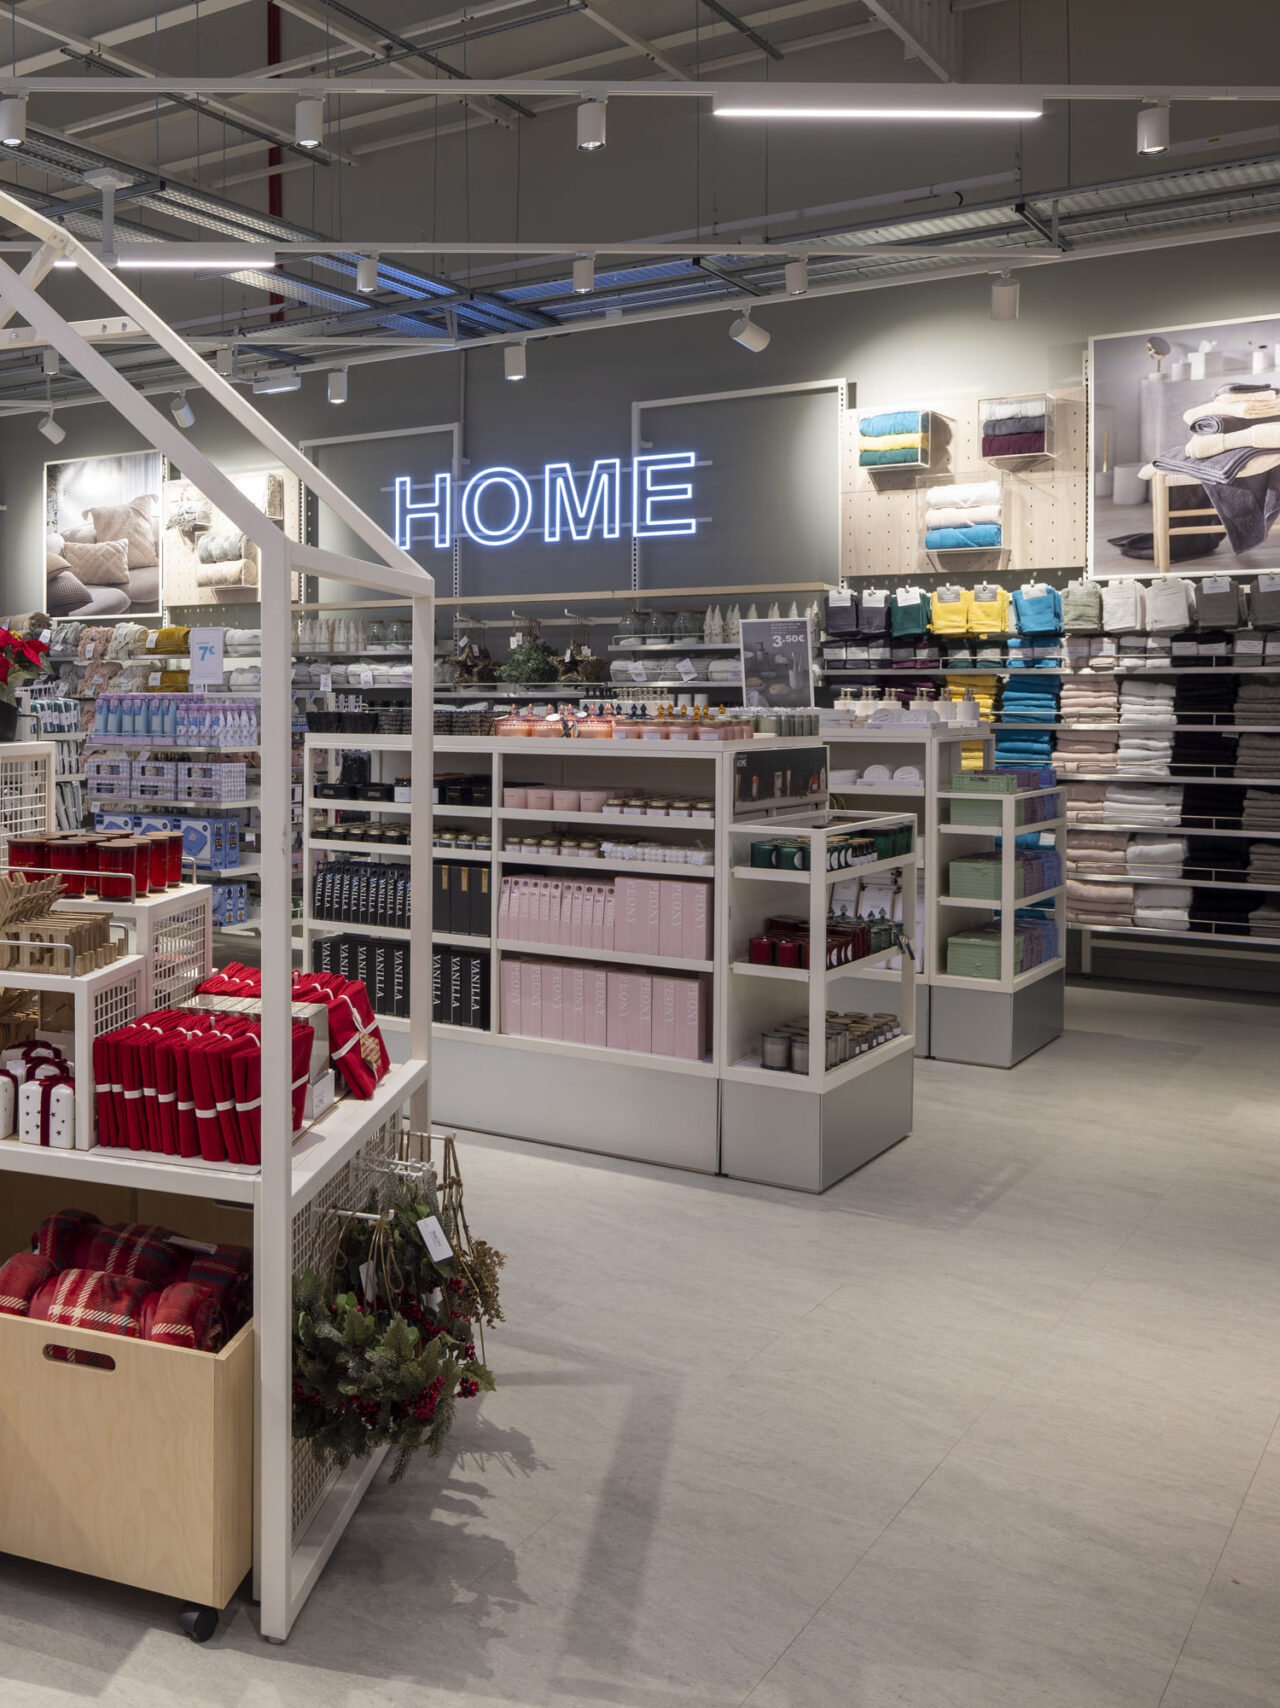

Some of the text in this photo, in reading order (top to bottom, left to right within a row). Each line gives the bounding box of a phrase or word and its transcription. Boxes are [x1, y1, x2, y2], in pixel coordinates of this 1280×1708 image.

[395, 452, 696, 550] HOME
[198, 645, 215, 661] 7€
[315, 873, 323, 906] VANILLA
[342, 874, 350, 909] VANILLA
[626, 880, 637, 925] PEONY
[648, 883, 659, 927] PEONY
[672, 885, 682, 928] PEONY
[696, 886, 705, 929] PEONY
[376, 948, 385, 998] VANILLA
[394, 950, 403, 1000] VANILLA
[432, 955, 441, 1005] VANILLA
[451, 956, 460, 1008] VANILLA
[471, 959, 480, 1010] VANILLA
[511, 964, 520, 1006] PEONY
[531, 966, 541, 1008] PEONY
[552, 967, 562, 1009] PEONY
[574, 969, 583, 1012] PEONY
[596, 972, 605, 1016] PEONY
[619, 975, 629, 1017] PEONY
[640, 977, 650, 1020] PEONY
[664, 980, 674, 1024] PEONY
[687, 983, 697, 1025] PEONY
